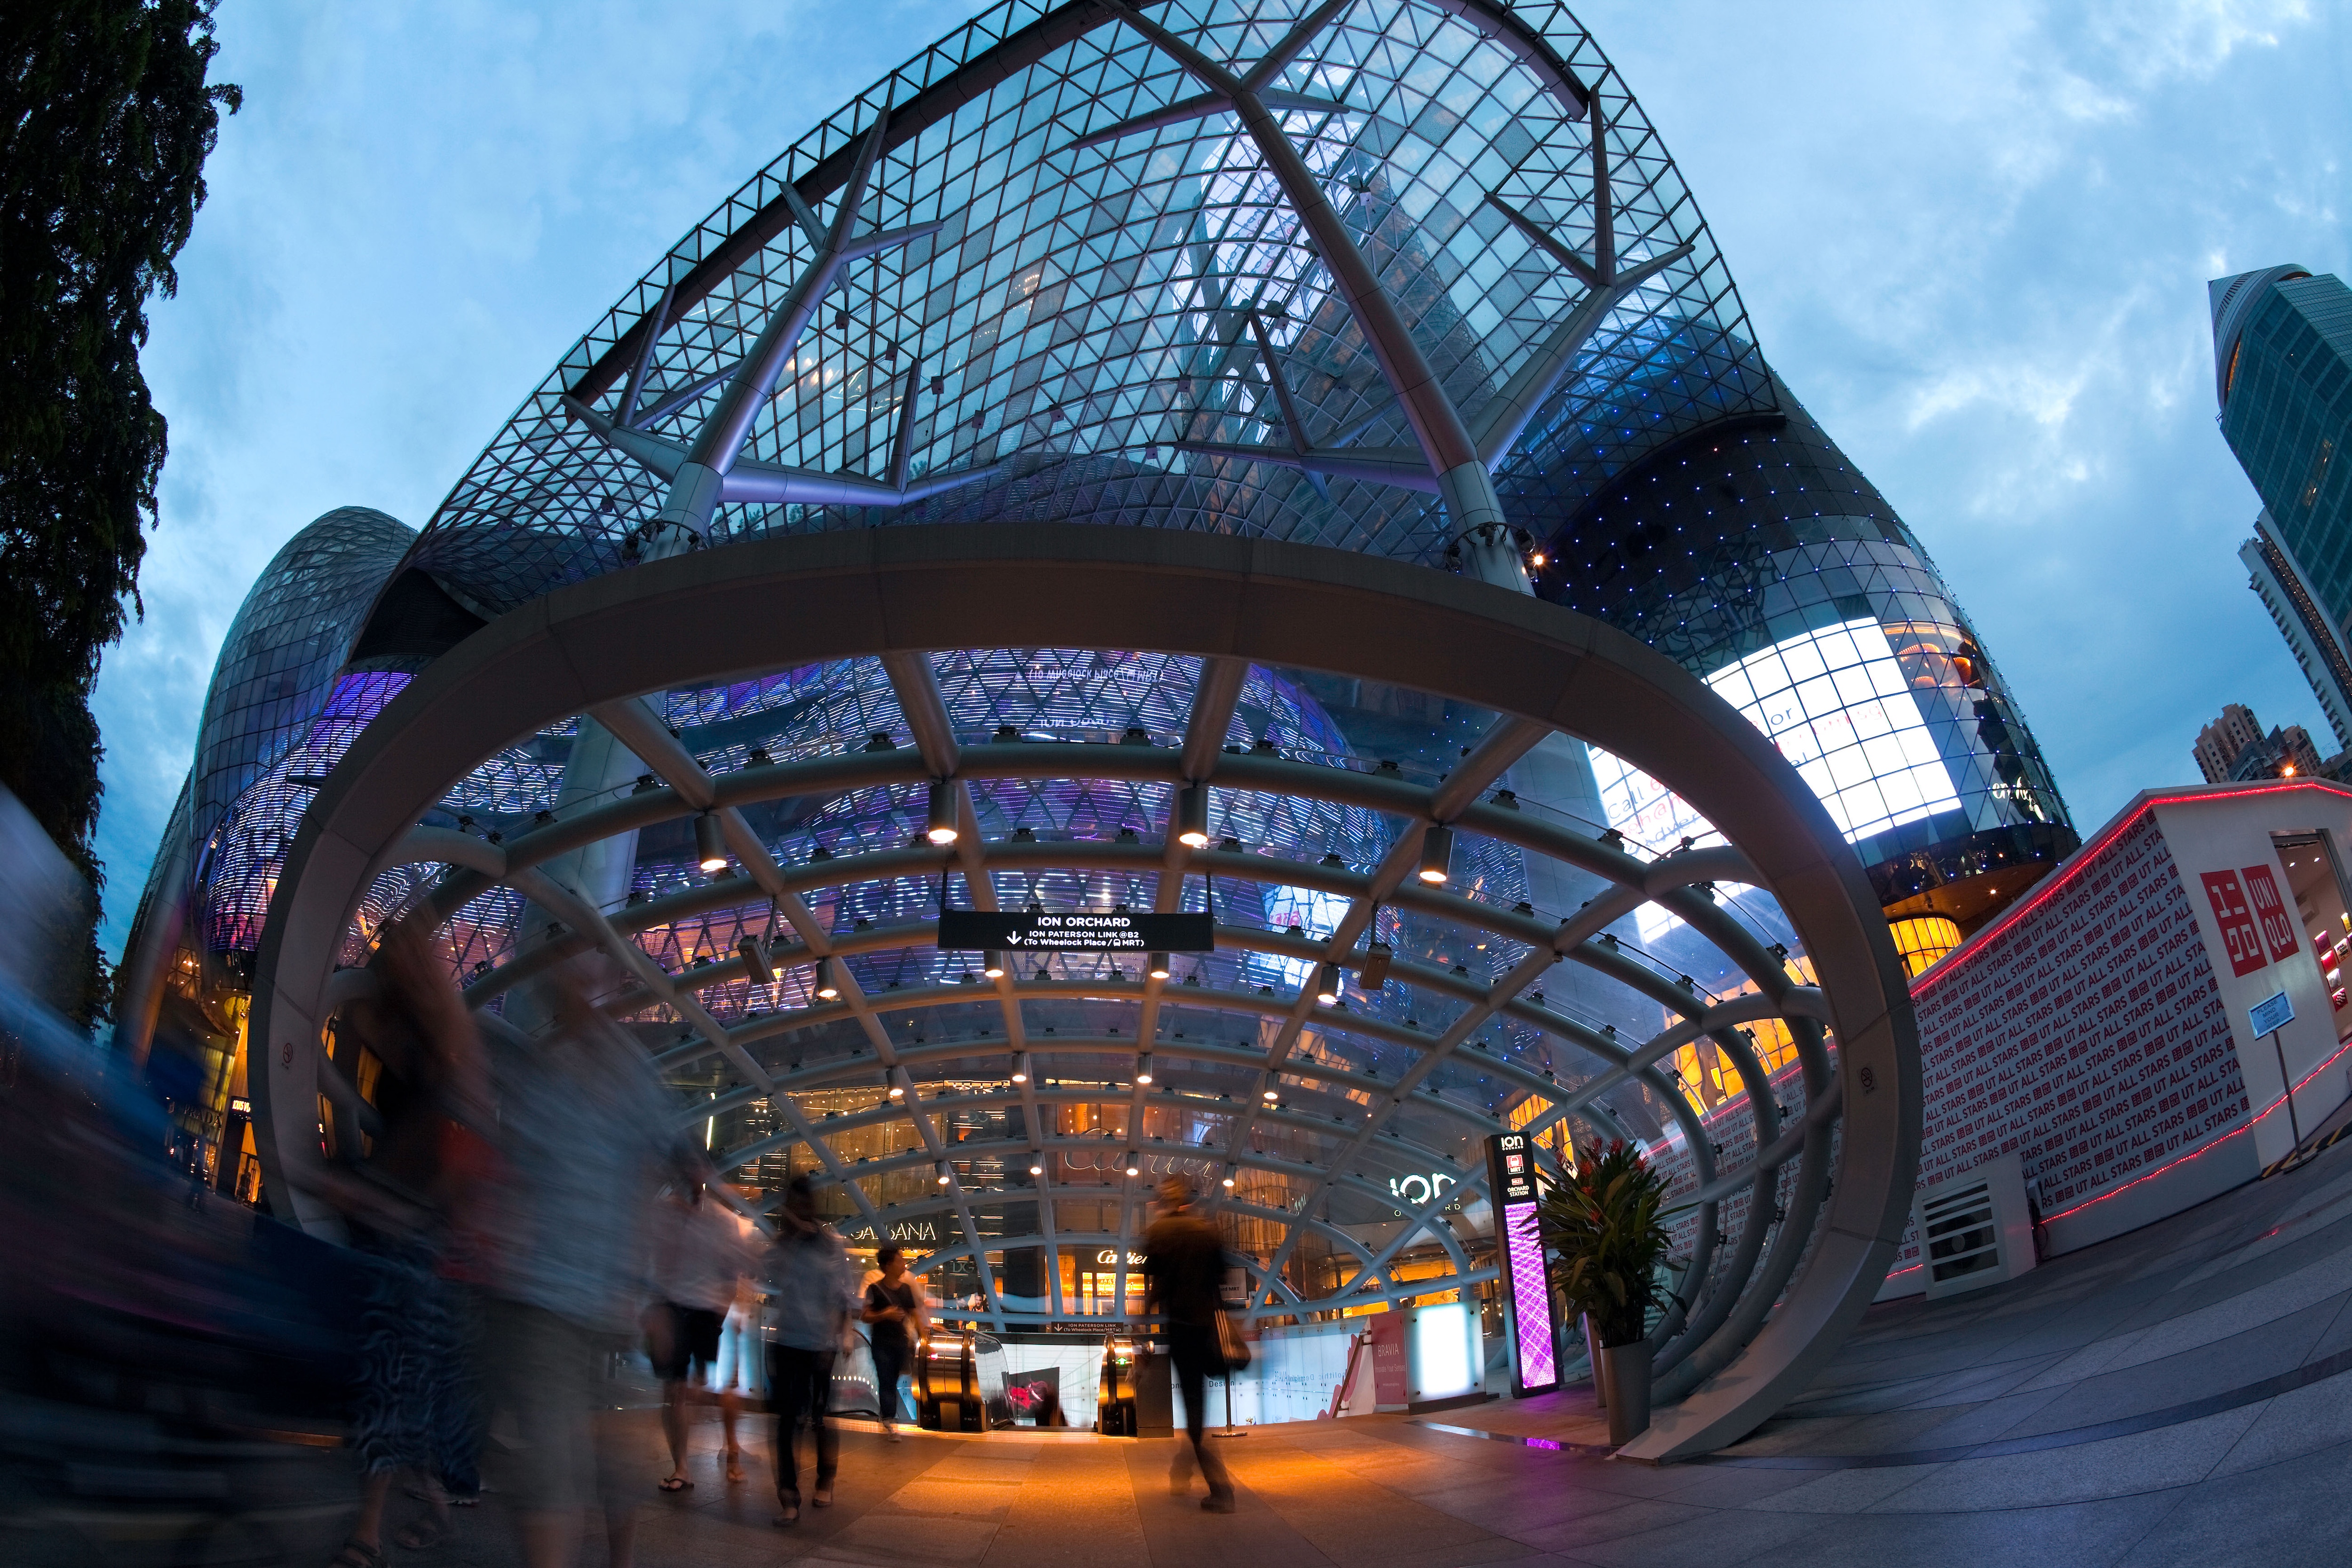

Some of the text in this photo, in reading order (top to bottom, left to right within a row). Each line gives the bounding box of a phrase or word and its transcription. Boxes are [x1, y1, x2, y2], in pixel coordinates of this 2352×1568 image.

[2083, 818, 2145, 878] UT ALL STARS
[1038, 917, 1130, 927] ION ORCHARD
[1986, 846, 2145, 975] STARS UT ALL STARS UT ALL
[2056, 860, 2152, 944] UT ALL STARS UT
[2249, 877, 2278, 910] UNI
[2023, 872, 2168, 989] UT ALL STARS UT ALL STARS
[2048, 900, 2166, 992] UT ALL STARS UT ALL
[2265, 913, 2292, 953] QLO
[1994, 915, 2172, 1046] UT ALL STARS UT ALL STARS UT
[2015, 956, 2186, 1073] STARS UT ALL STARS UT ALL
[2038, 928, 2188, 1039] UT ALL STARS UT ALL STARS
[2088, 970, 2191, 1047] UT ALL STARS UT
[2257, 999, 2277, 1014] PLEASE
[2263, 1007, 2276, 1018] MIND
[2051, 985, 2207, 1089] UT ALL STARS UT ALL STARS
[2264, 1012, 2279, 1023] YOUR
[1782, 1073, 1801, 1089] STARS
[2019, 1029, 2208, 1145] UT ALL STARS UT ALL STARS UT
[2077, 1013, 2203, 1095] UT ALL STARS UT ALL
[1726, 1111, 1735, 1123] ALL
[1735, 1102, 1751, 1117] STARS
[1731, 1117, 1749, 1132] UT ALL
[2038, 1071, 2219, 1173] STARS UT ALL STARS UT ALL
[2064, 1043, 2224, 1141] UT ALL STARS UT ALL STARS
[2115, 1087, 2223, 1156] UT ALL STARS UT
[1666, 1156, 1679, 1166] STARS
[1677, 1160, 1691, 1172] STARS
[1732, 1148, 1742, 1158] ALL
[2075, 1103, 2238, 1194] UT ALL STARS UT ALL STARS
[1378, 1343, 1399, 1357] BRAVIA
